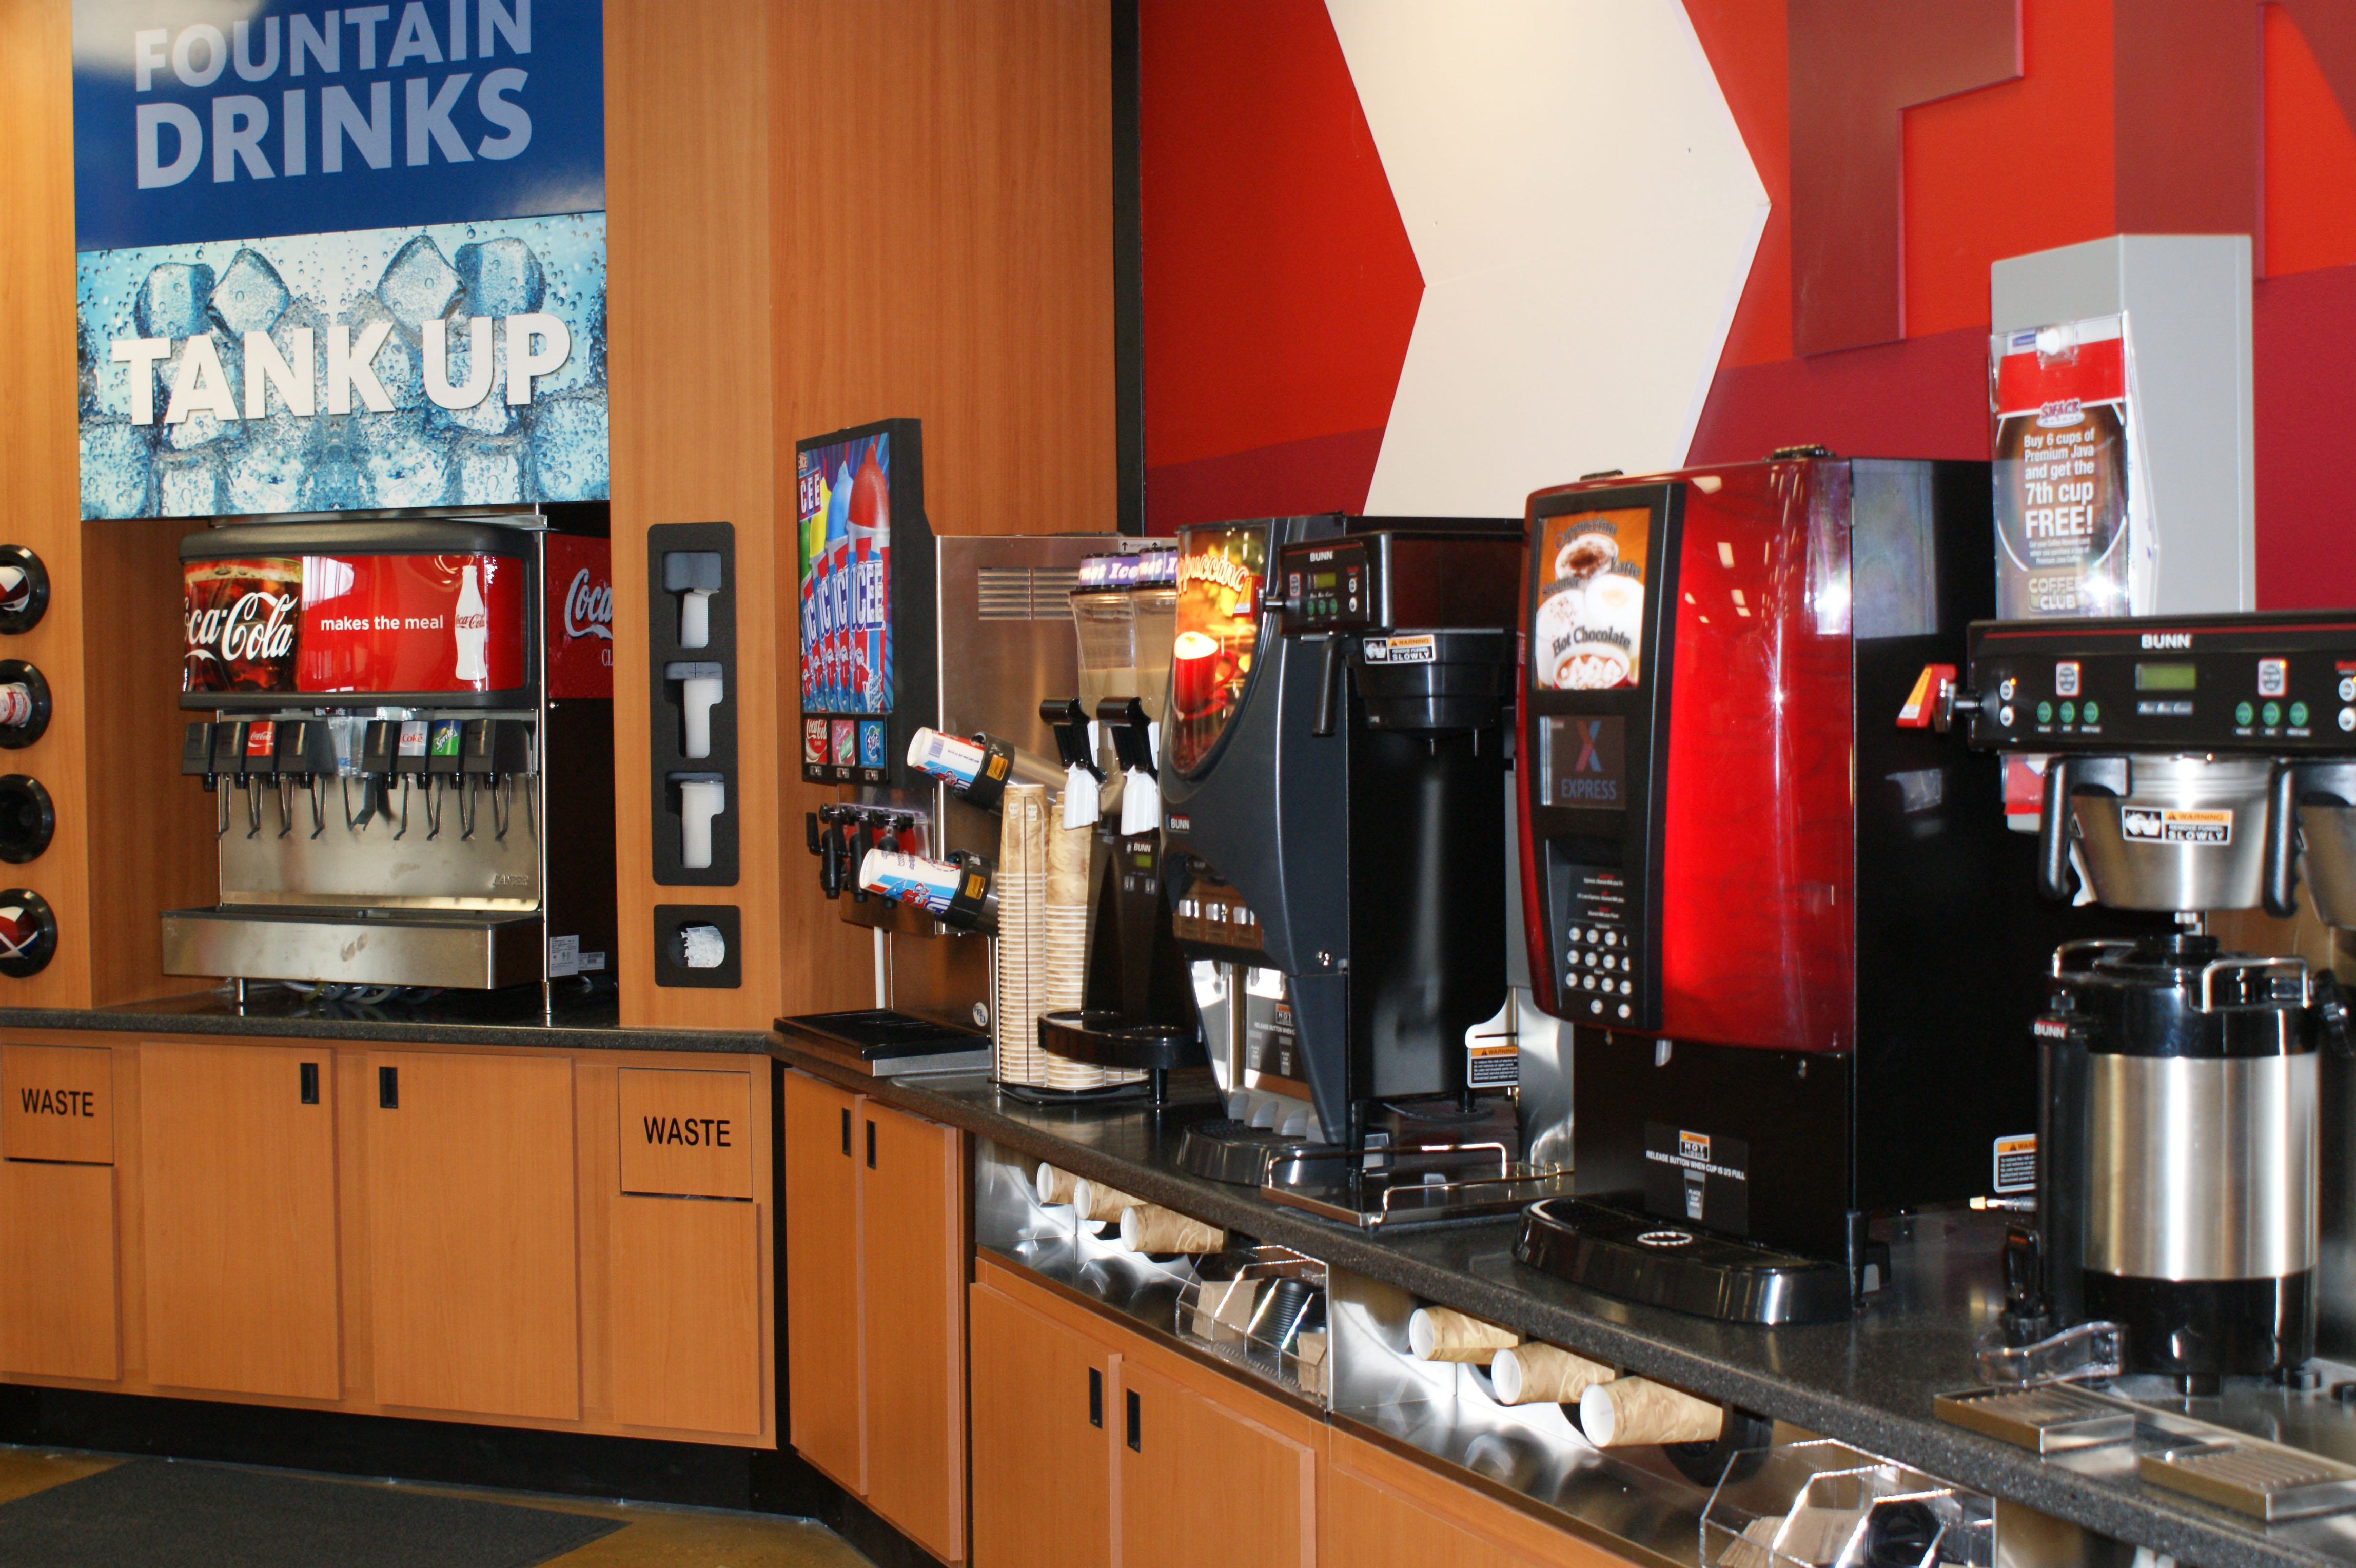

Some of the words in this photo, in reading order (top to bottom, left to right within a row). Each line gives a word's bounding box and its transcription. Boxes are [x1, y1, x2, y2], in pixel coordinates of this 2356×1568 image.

[135, 0, 532, 92] FOUNTAIN
[135, 68, 533, 190] DRINKS
[111, 321, 396, 426] TANK
[422, 313, 572, 410] UP
[2024, 435, 2043, 449] Buy
[2046, 433, 2053, 446] 6
[2055, 432, 2082, 446] cups
[2084, 427, 2095, 441] of
[2024, 447, 2068, 463] Premium
[2070, 444, 2094, 458] Java
[2025, 463, 2047, 480] and
[2050, 461, 2071, 481] get
[2074, 460, 2094, 475] the
[2024, 480, 2053, 505] 7th
[2058, 481, 2094, 506] cup
[2025, 505, 2093, 538] FREE!
[1310, 551, 1333, 562] BUNN
[851, 560, 885, 632] ICEE
[2039, 594, 2077, 611] CLUB
[321, 616, 369, 631] makes
[374, 615, 400, 630] the
[405, 615, 443, 629] meal
[1552, 632, 1572, 658] Hot
[1573, 625, 1631, 650] Chocolate
[2141, 633, 2192, 649] BUNN
[1392, 652, 1430, 661] SLOWLY
[402, 733, 423, 743] Coke
[1560, 778, 1616, 800] EXPRESS
[1171, 818, 1189, 829] BUNN
[2177, 813, 2224, 821] WARNING
[2168, 830, 2223, 841] SLOWLY
[1133, 842, 1151, 853] BUNN
[2034, 1023, 2065, 1039] BUNN
[21, 1087, 95, 1117] WASTE
[643, 1115, 732, 1147] WASTE
[1684, 1142, 1705, 1153] HOT
[1646, 1149, 1668, 1163] RELEASE
[1669, 1155, 1690, 1167] BUTTON
[1690, 1160, 1705, 1171] WHEN
[1706, 1163, 1717, 1173] CUP
[1717, 1166, 1723, 1175] IS
